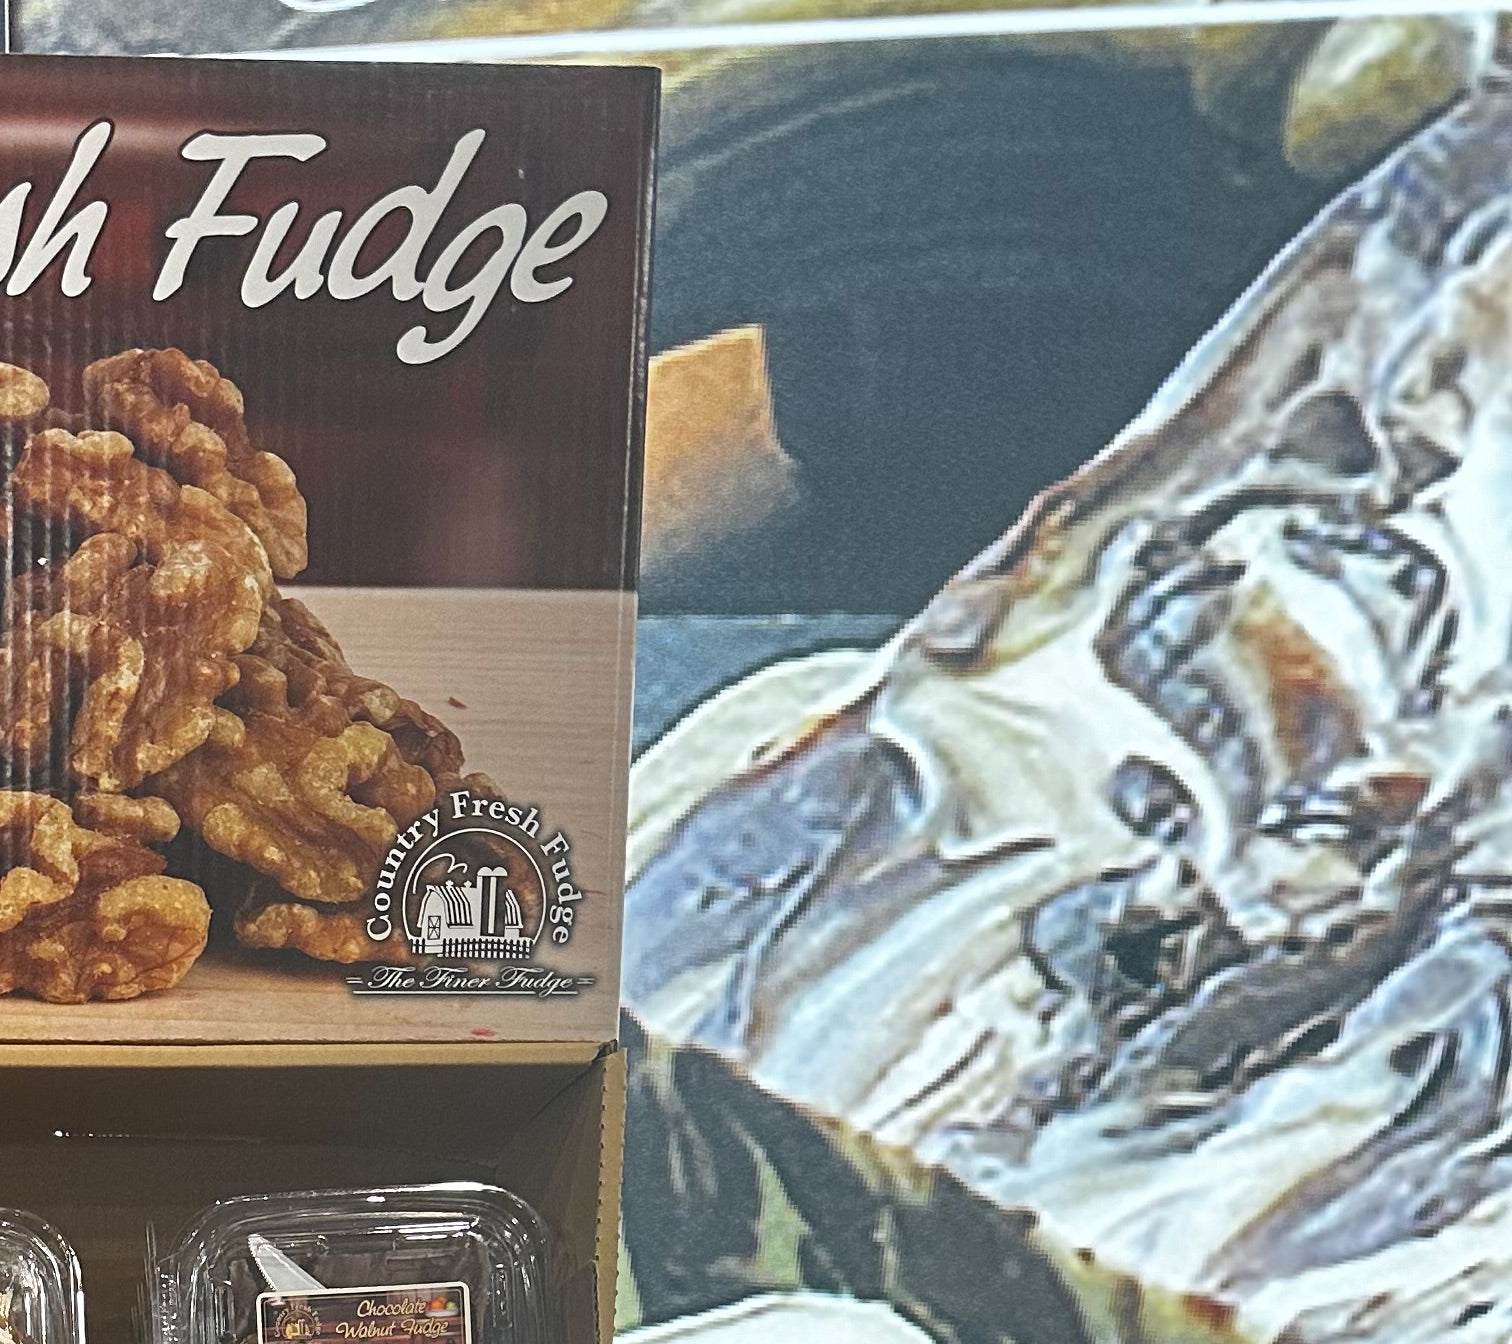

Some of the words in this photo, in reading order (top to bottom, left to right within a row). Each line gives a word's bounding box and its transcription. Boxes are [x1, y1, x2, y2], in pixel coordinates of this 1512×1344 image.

[151, 127, 610, 366] Fudge
[365, 806, 440, 942] Country
[449, 790, 542, 838] Fresh
[539, 832, 583, 944] Fudge
[367, 965, 417, 990] The
[418, 965, 491, 990] Finer
[494, 965, 574, 999] Fudge
[356, 1297, 428, 1318] Chocolate
[335, 1319, 396, 1339] Walnut
[400, 1317, 449, 1339] Fudge
